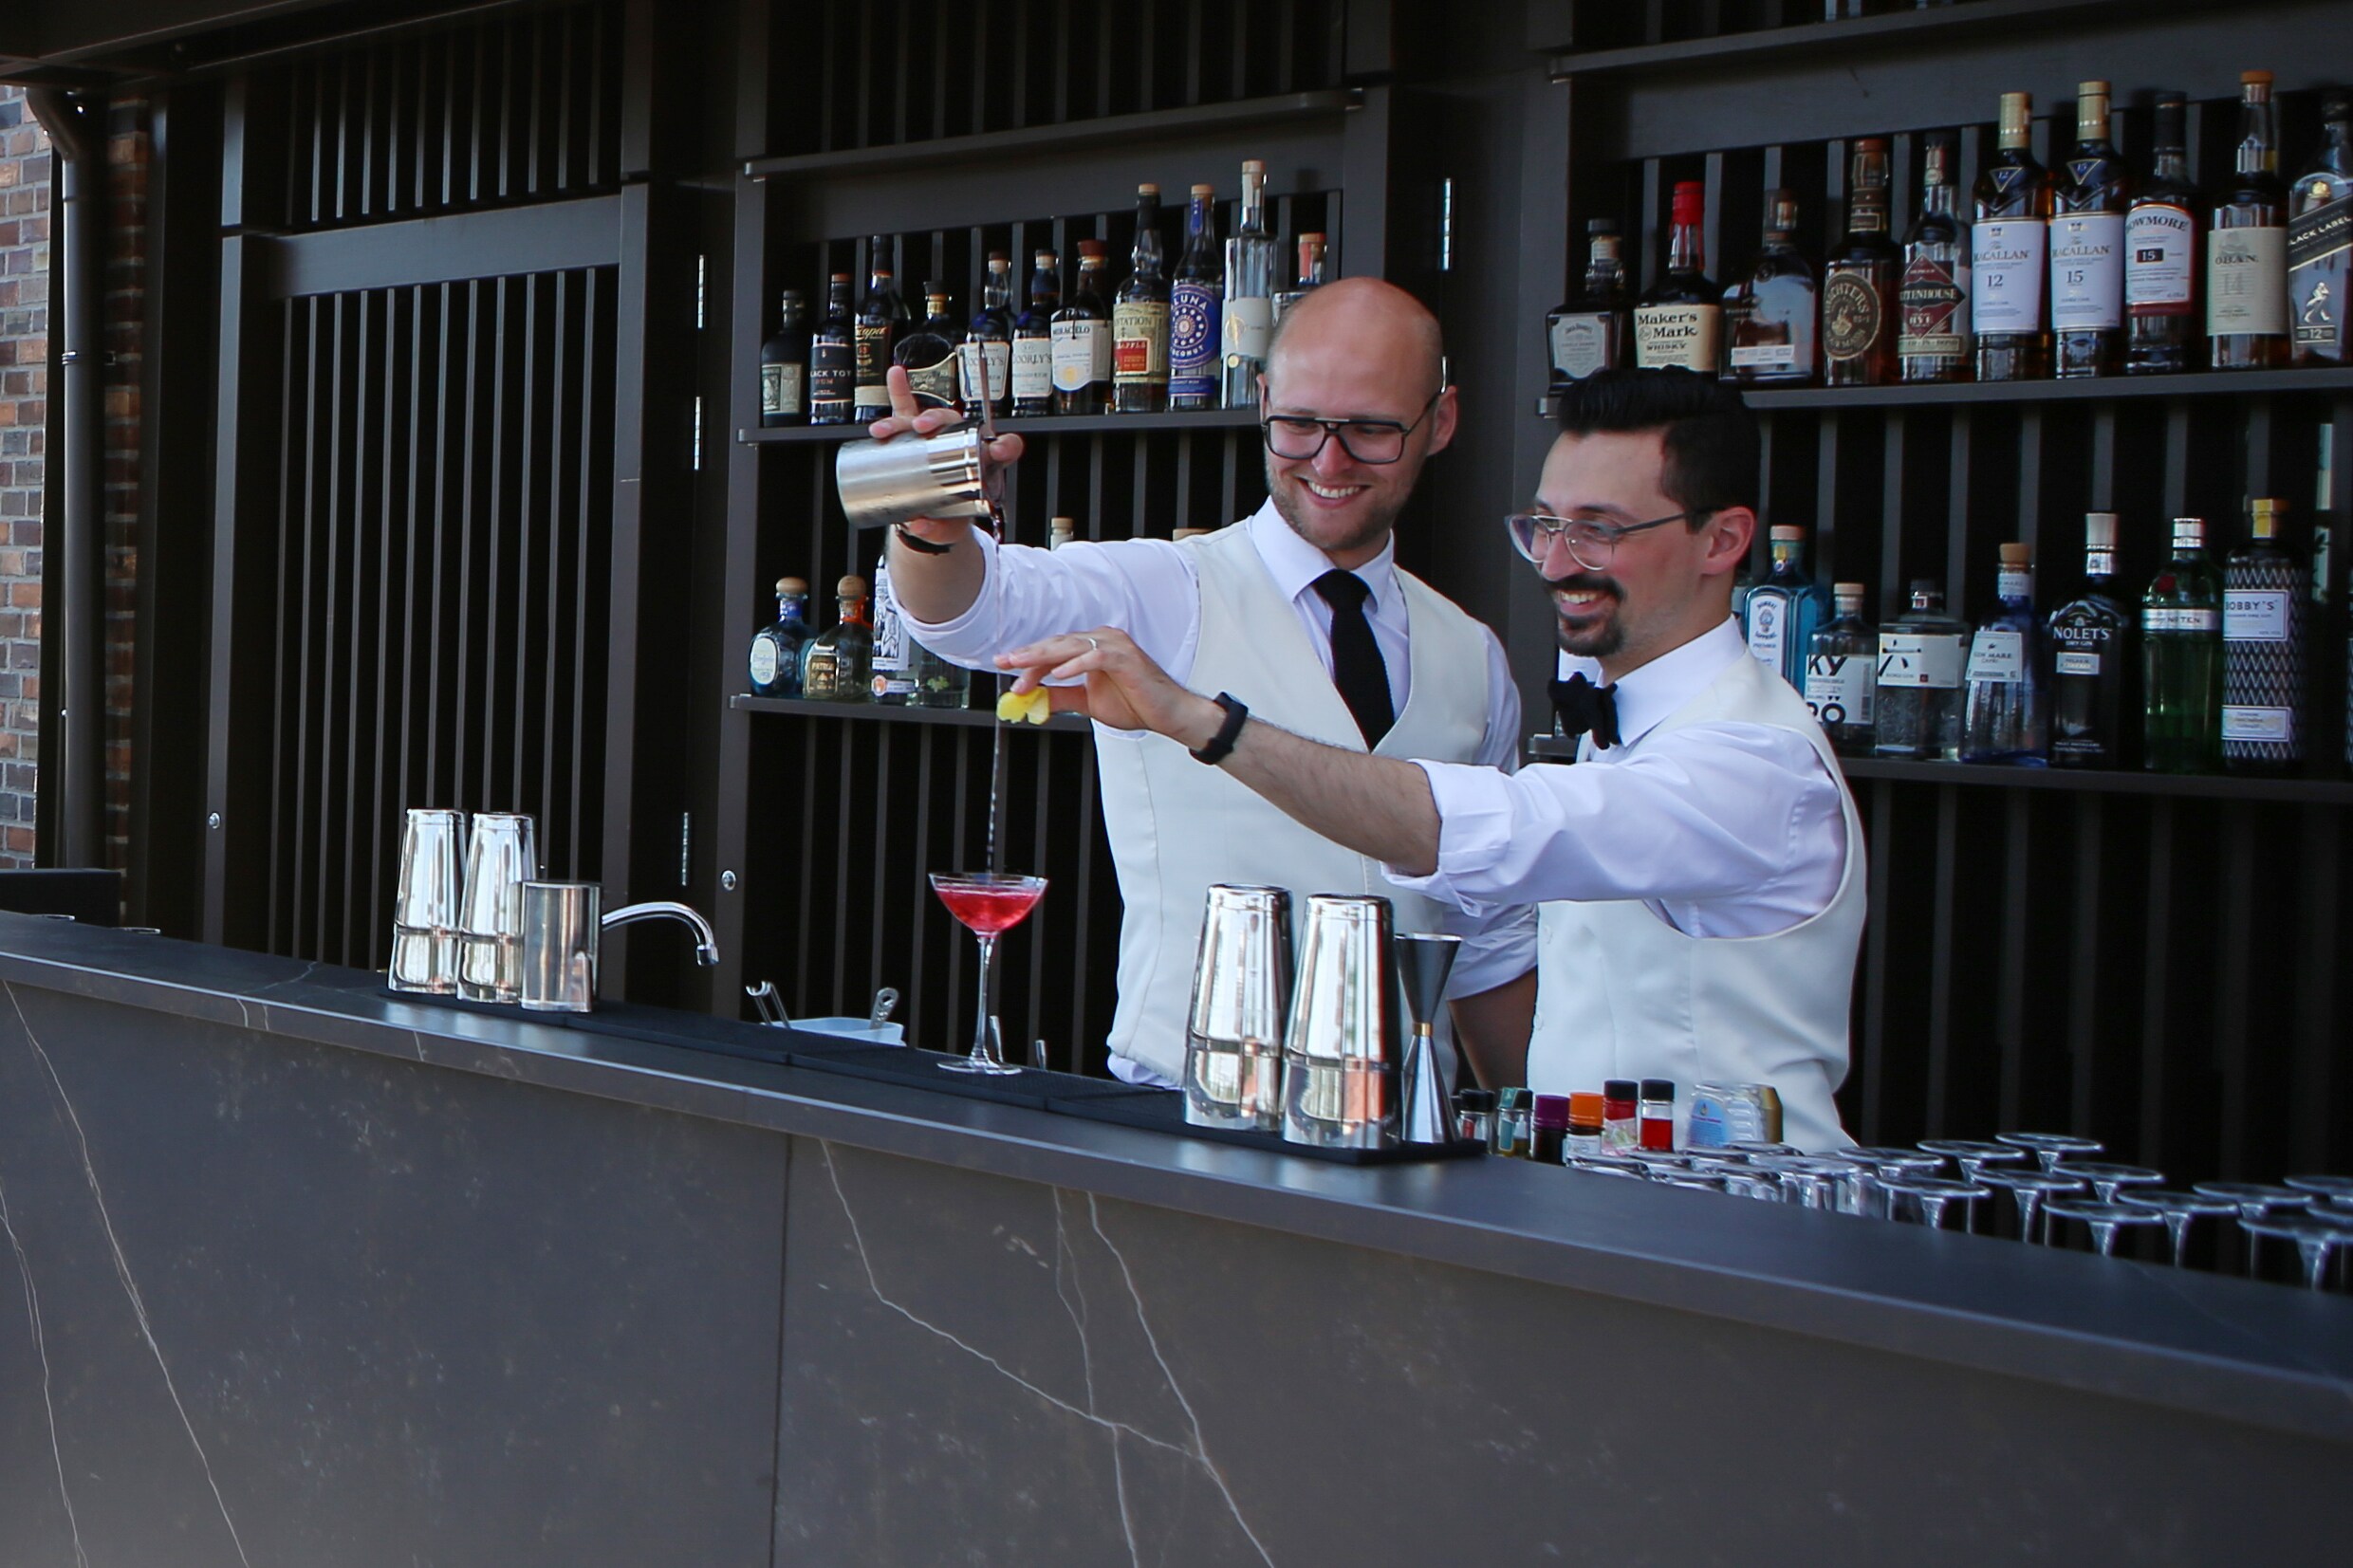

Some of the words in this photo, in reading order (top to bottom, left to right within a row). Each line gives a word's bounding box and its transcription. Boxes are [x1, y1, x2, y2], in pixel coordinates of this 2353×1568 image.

[2318, 216, 2351, 232] LABEL
[2141, 250, 2156, 261] 15
[1987, 274, 2004, 287] 12
[2066, 270, 2084, 284] 15
[1637, 312, 1697, 325] Maker's
[1653, 326, 1697, 339] Mark
[2309, 328, 2322, 339] 12
[2053, 626, 2110, 640] NOLET'S
